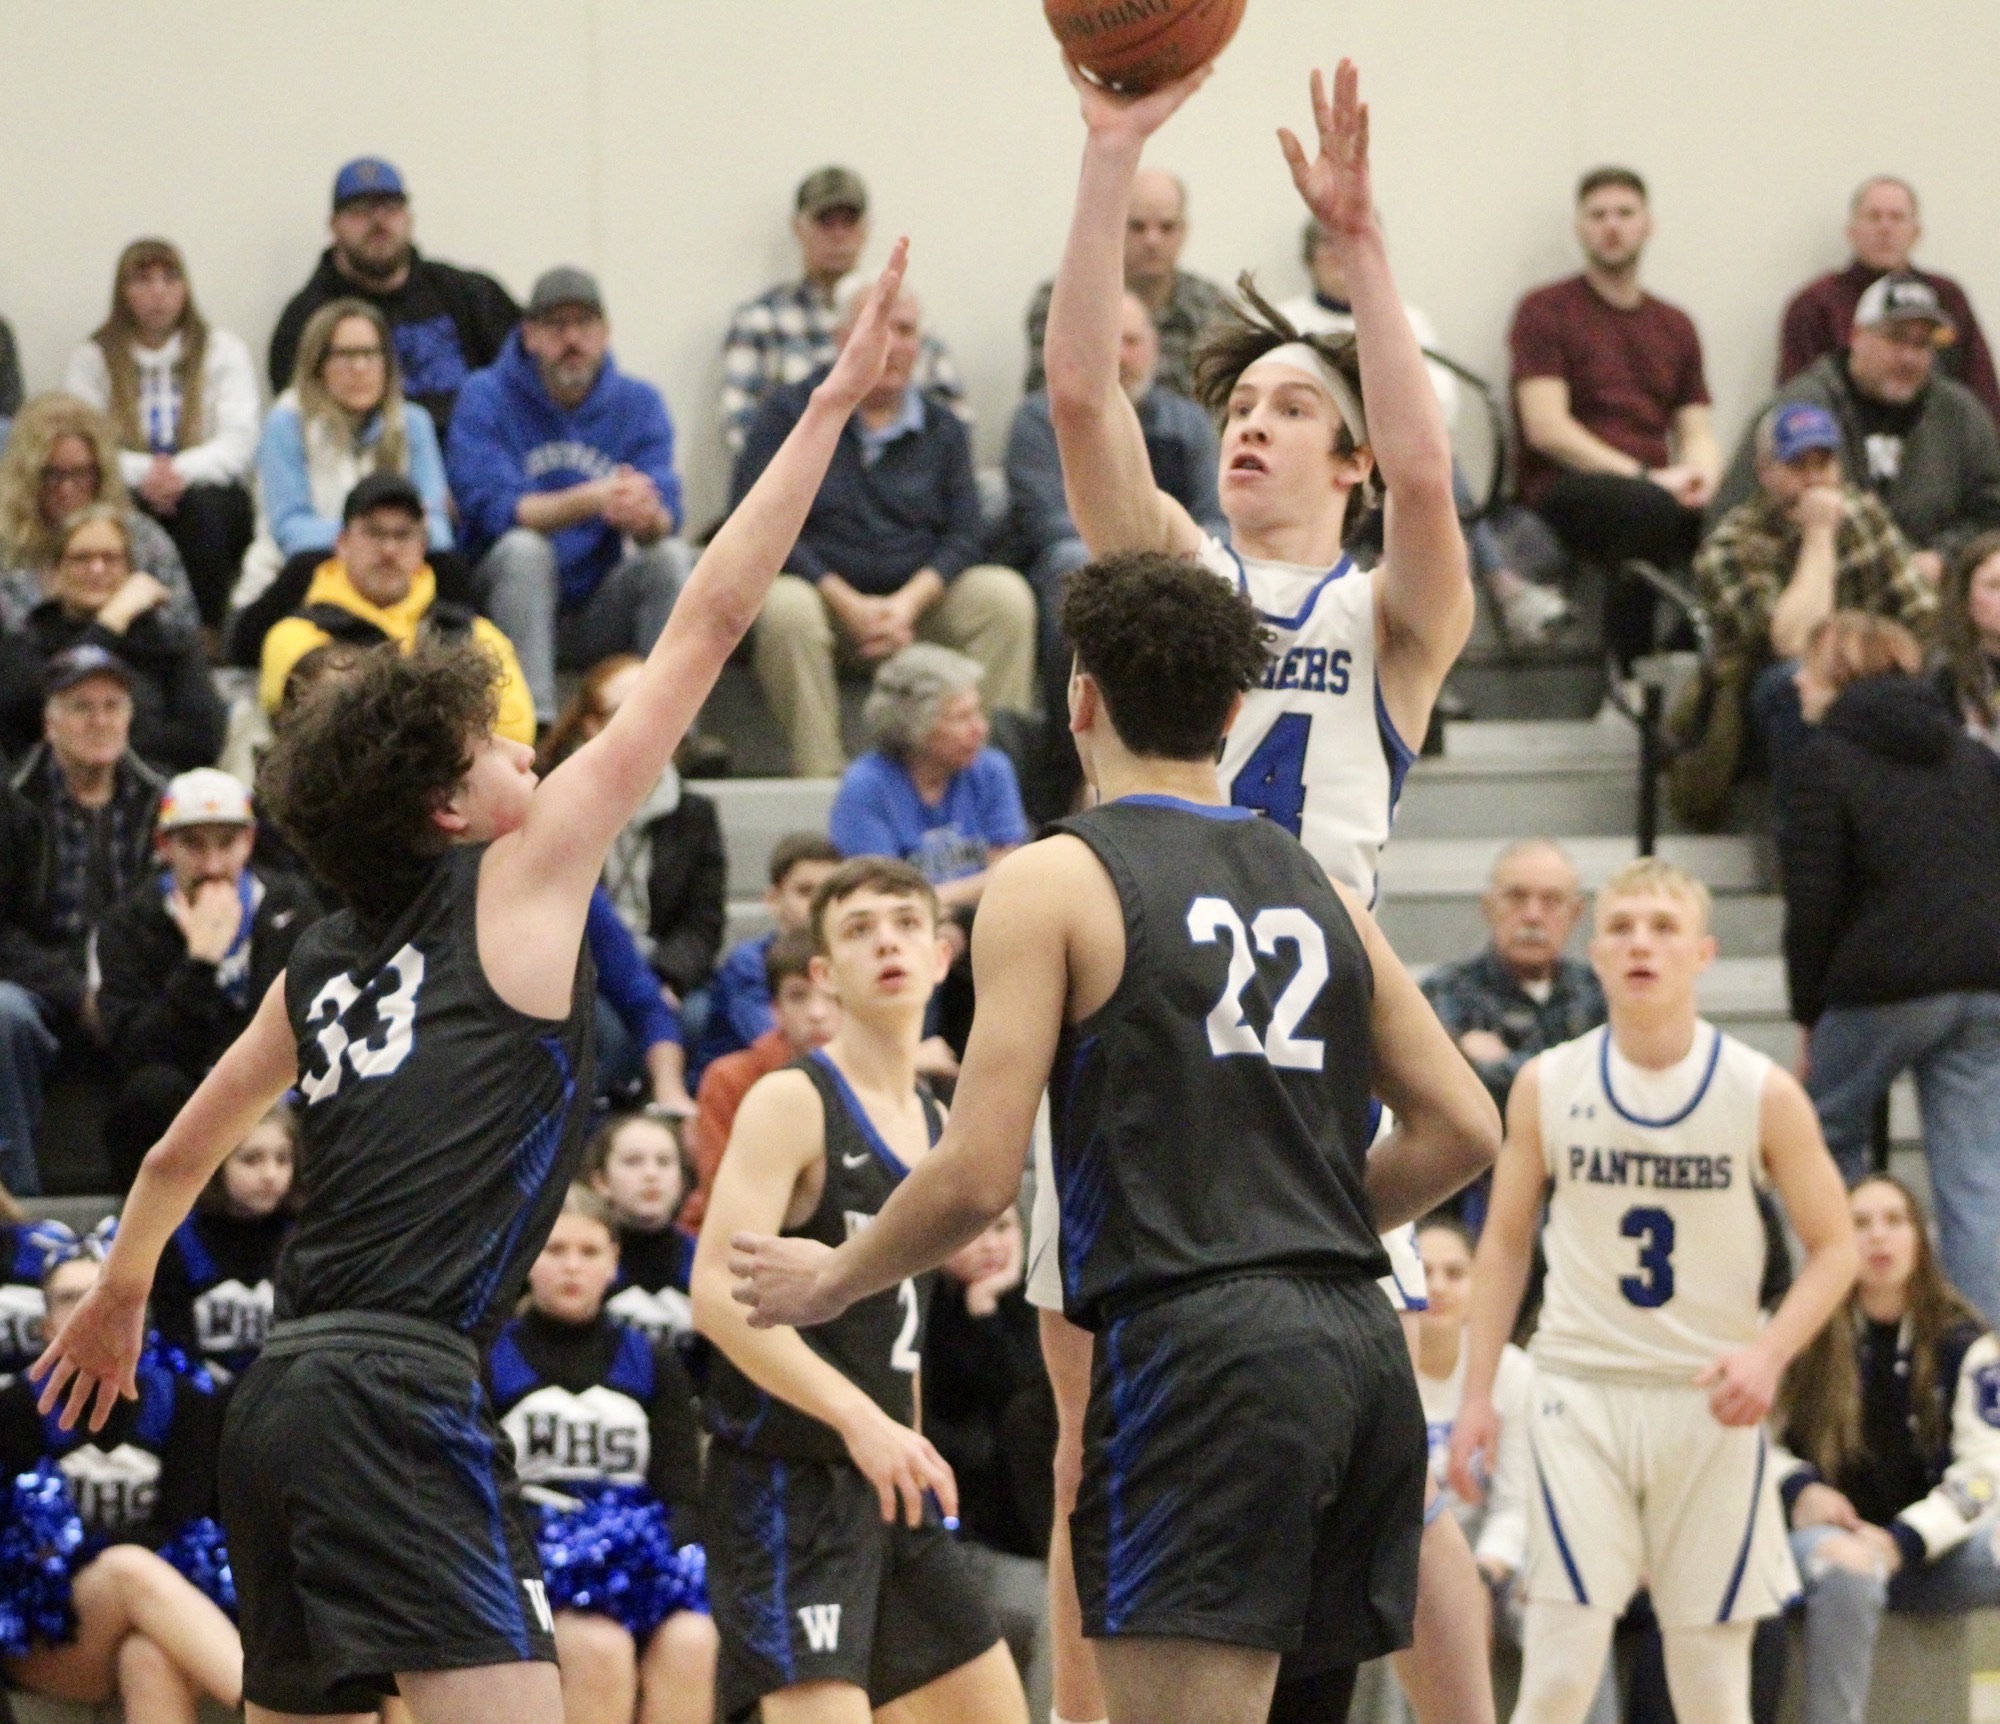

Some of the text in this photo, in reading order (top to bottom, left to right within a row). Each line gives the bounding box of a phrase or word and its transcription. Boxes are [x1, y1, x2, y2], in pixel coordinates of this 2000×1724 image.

[304, 942, 425, 1106] 33
[1187, 897, 1329, 1070] 22
[1568, 1144, 1732, 1189] PANTHERS
[1618, 1205, 1676, 1308] 3
[525, 1412, 638, 1474] WHS
[797, 1603, 842, 1652] W
